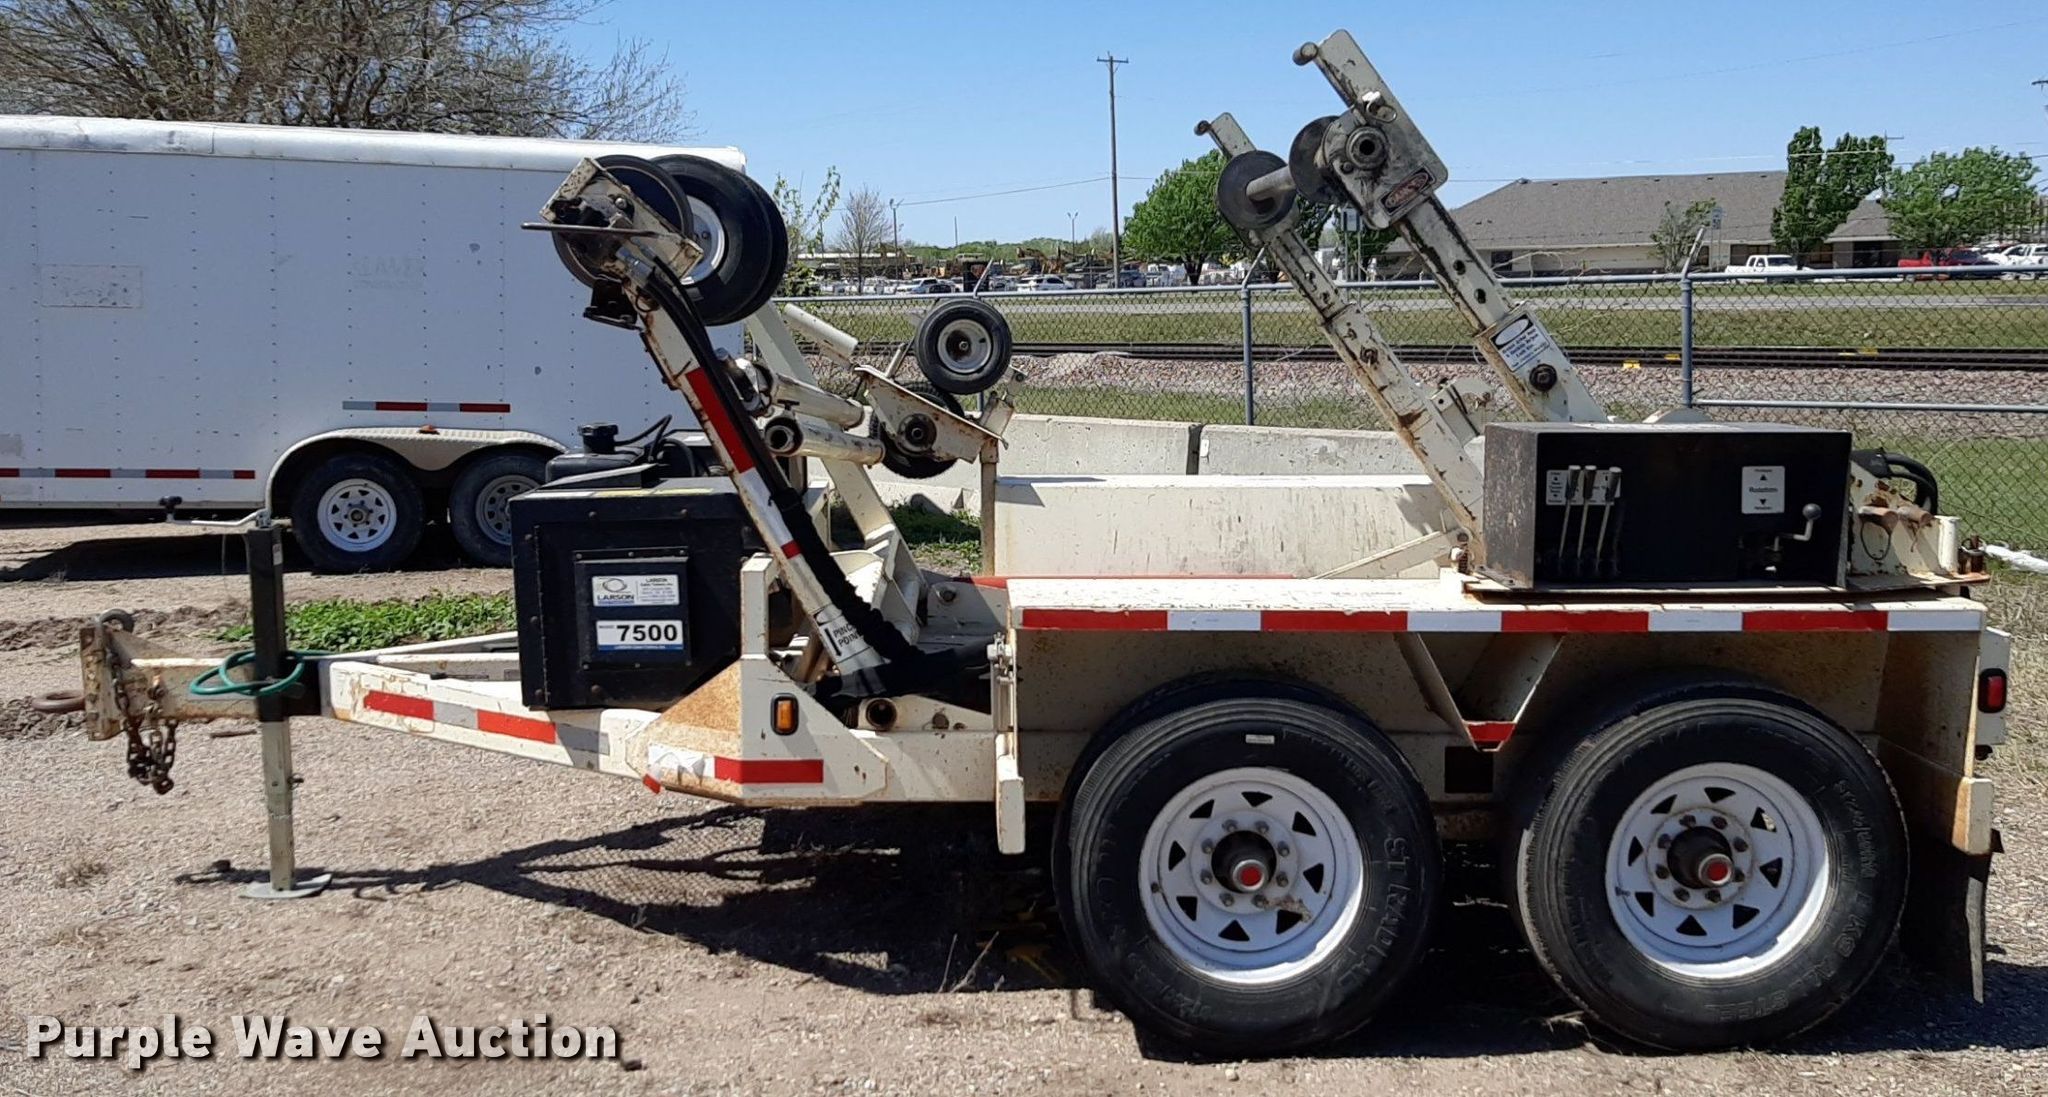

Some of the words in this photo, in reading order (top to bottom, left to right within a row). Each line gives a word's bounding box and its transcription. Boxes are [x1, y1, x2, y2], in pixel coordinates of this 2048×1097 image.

[616, 624, 678, 641] 7500
[833, 623, 854, 638] PINC
[838, 632, 859, 647] POIN
